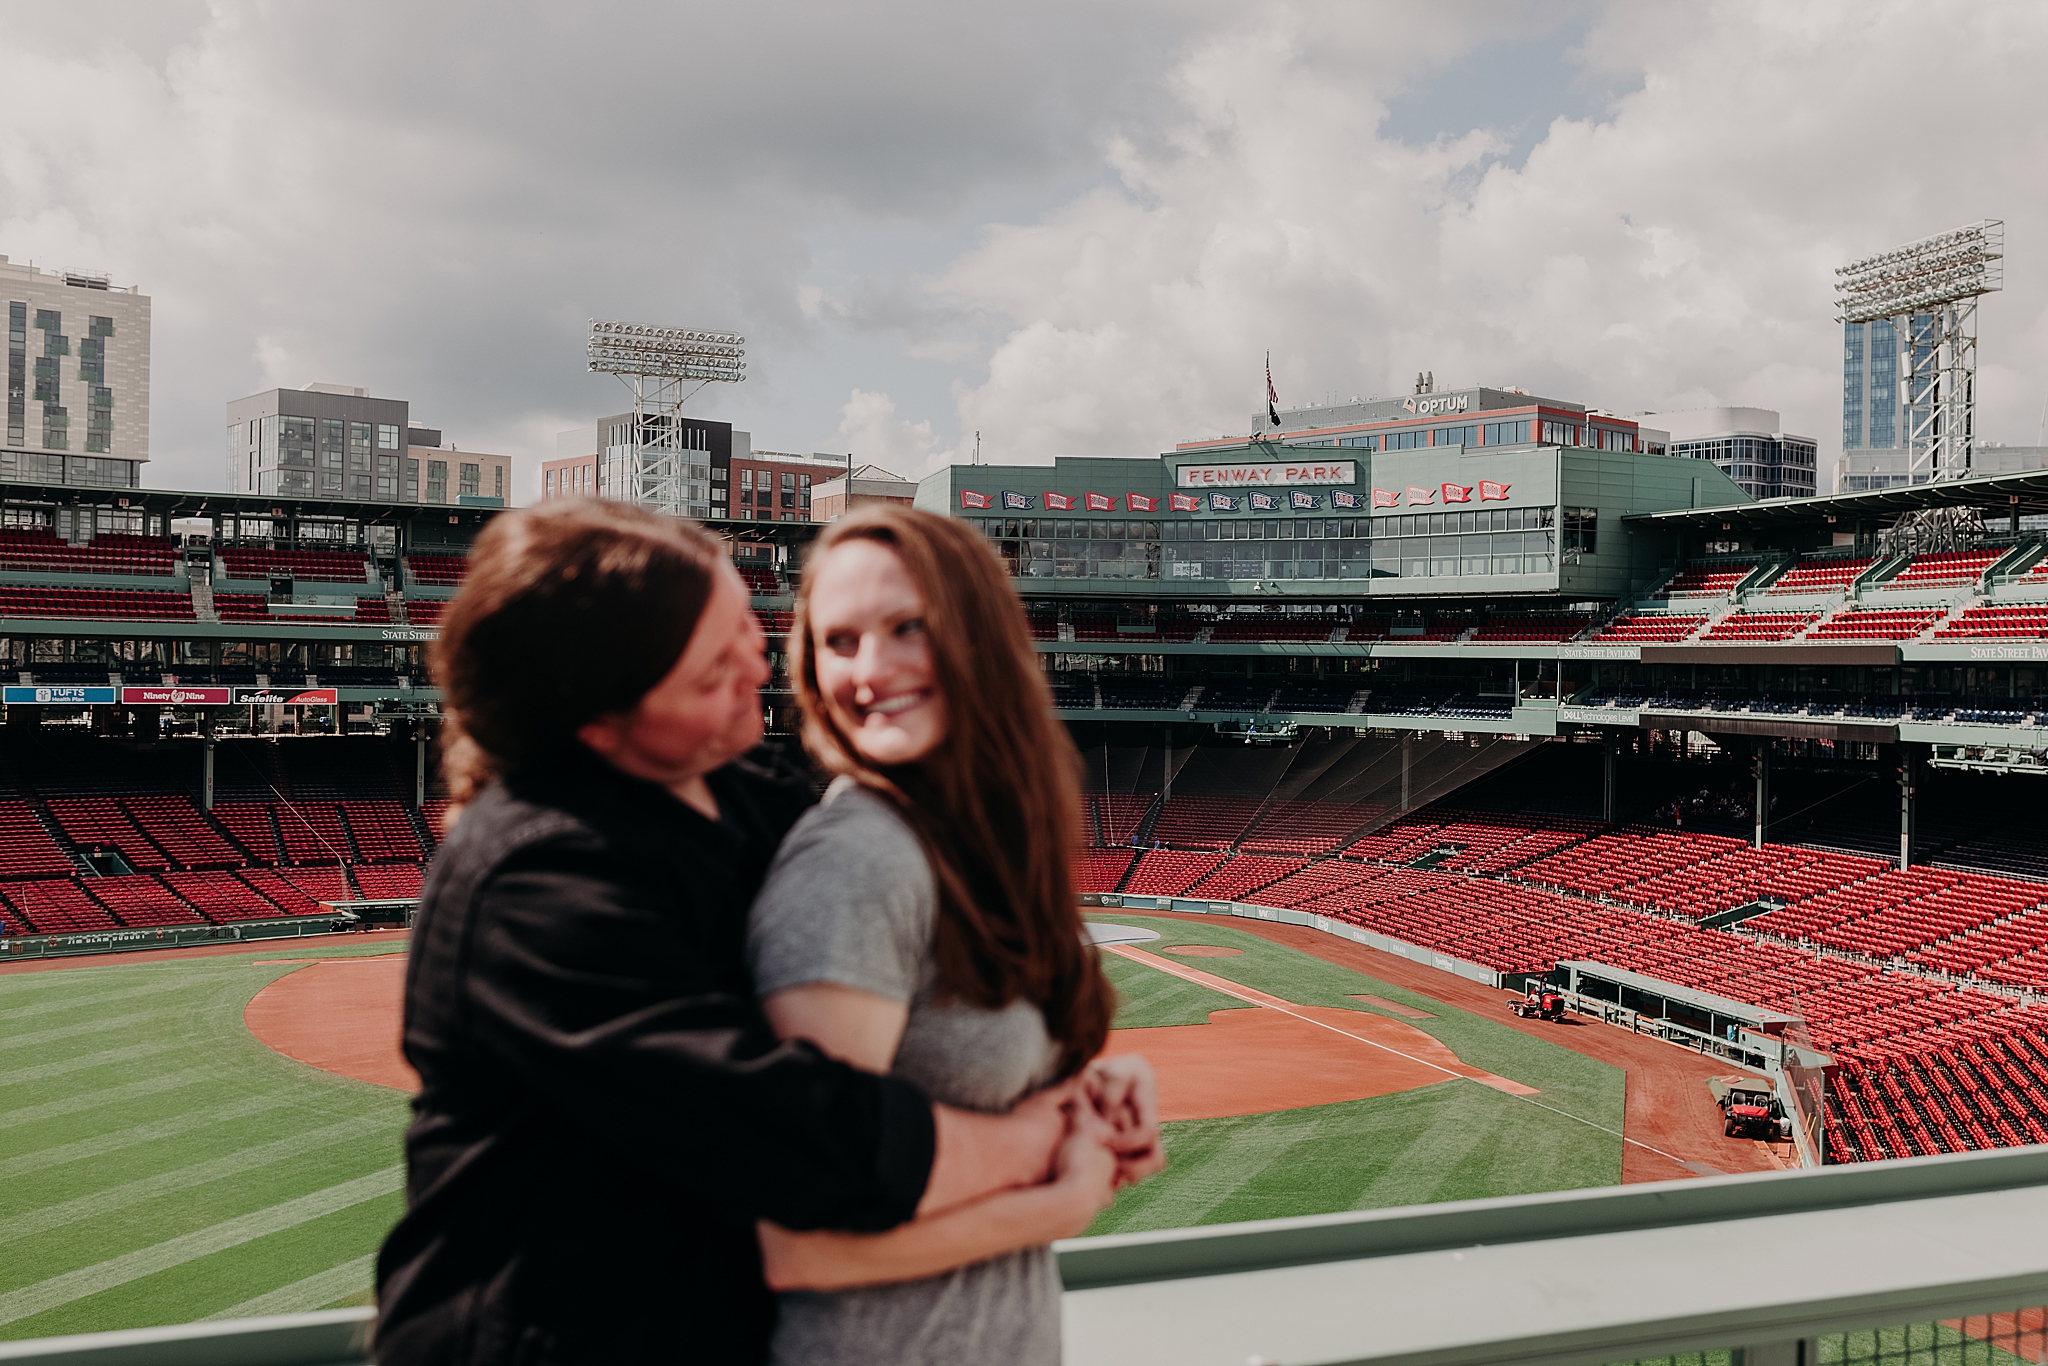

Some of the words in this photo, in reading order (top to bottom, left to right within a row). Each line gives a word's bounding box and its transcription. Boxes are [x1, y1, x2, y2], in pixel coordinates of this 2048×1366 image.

[1419, 395, 1468, 413] OPTUM
[1189, 468, 1272, 482] FENWAY
[1285, 466, 1341, 480] PARK
[382, 630, 408, 639] STATE
[409, 630, 440, 639] STREET
[1564, 648, 1582, 657] STATE
[1606, 648, 1637, 657] PAVILION
[1971, 646, 1996, 659] STATE
[52, 688, 85, 696] TUFTS
[143, 692, 170, 700] Ninety
[186, 692, 205, 700] Nine
[240, 694, 284, 703] Safelite
[1563, 711, 1581, 720] DELL
[1581, 711, 1617, 723] Technologies
[1618, 713, 1634, 722] Level
